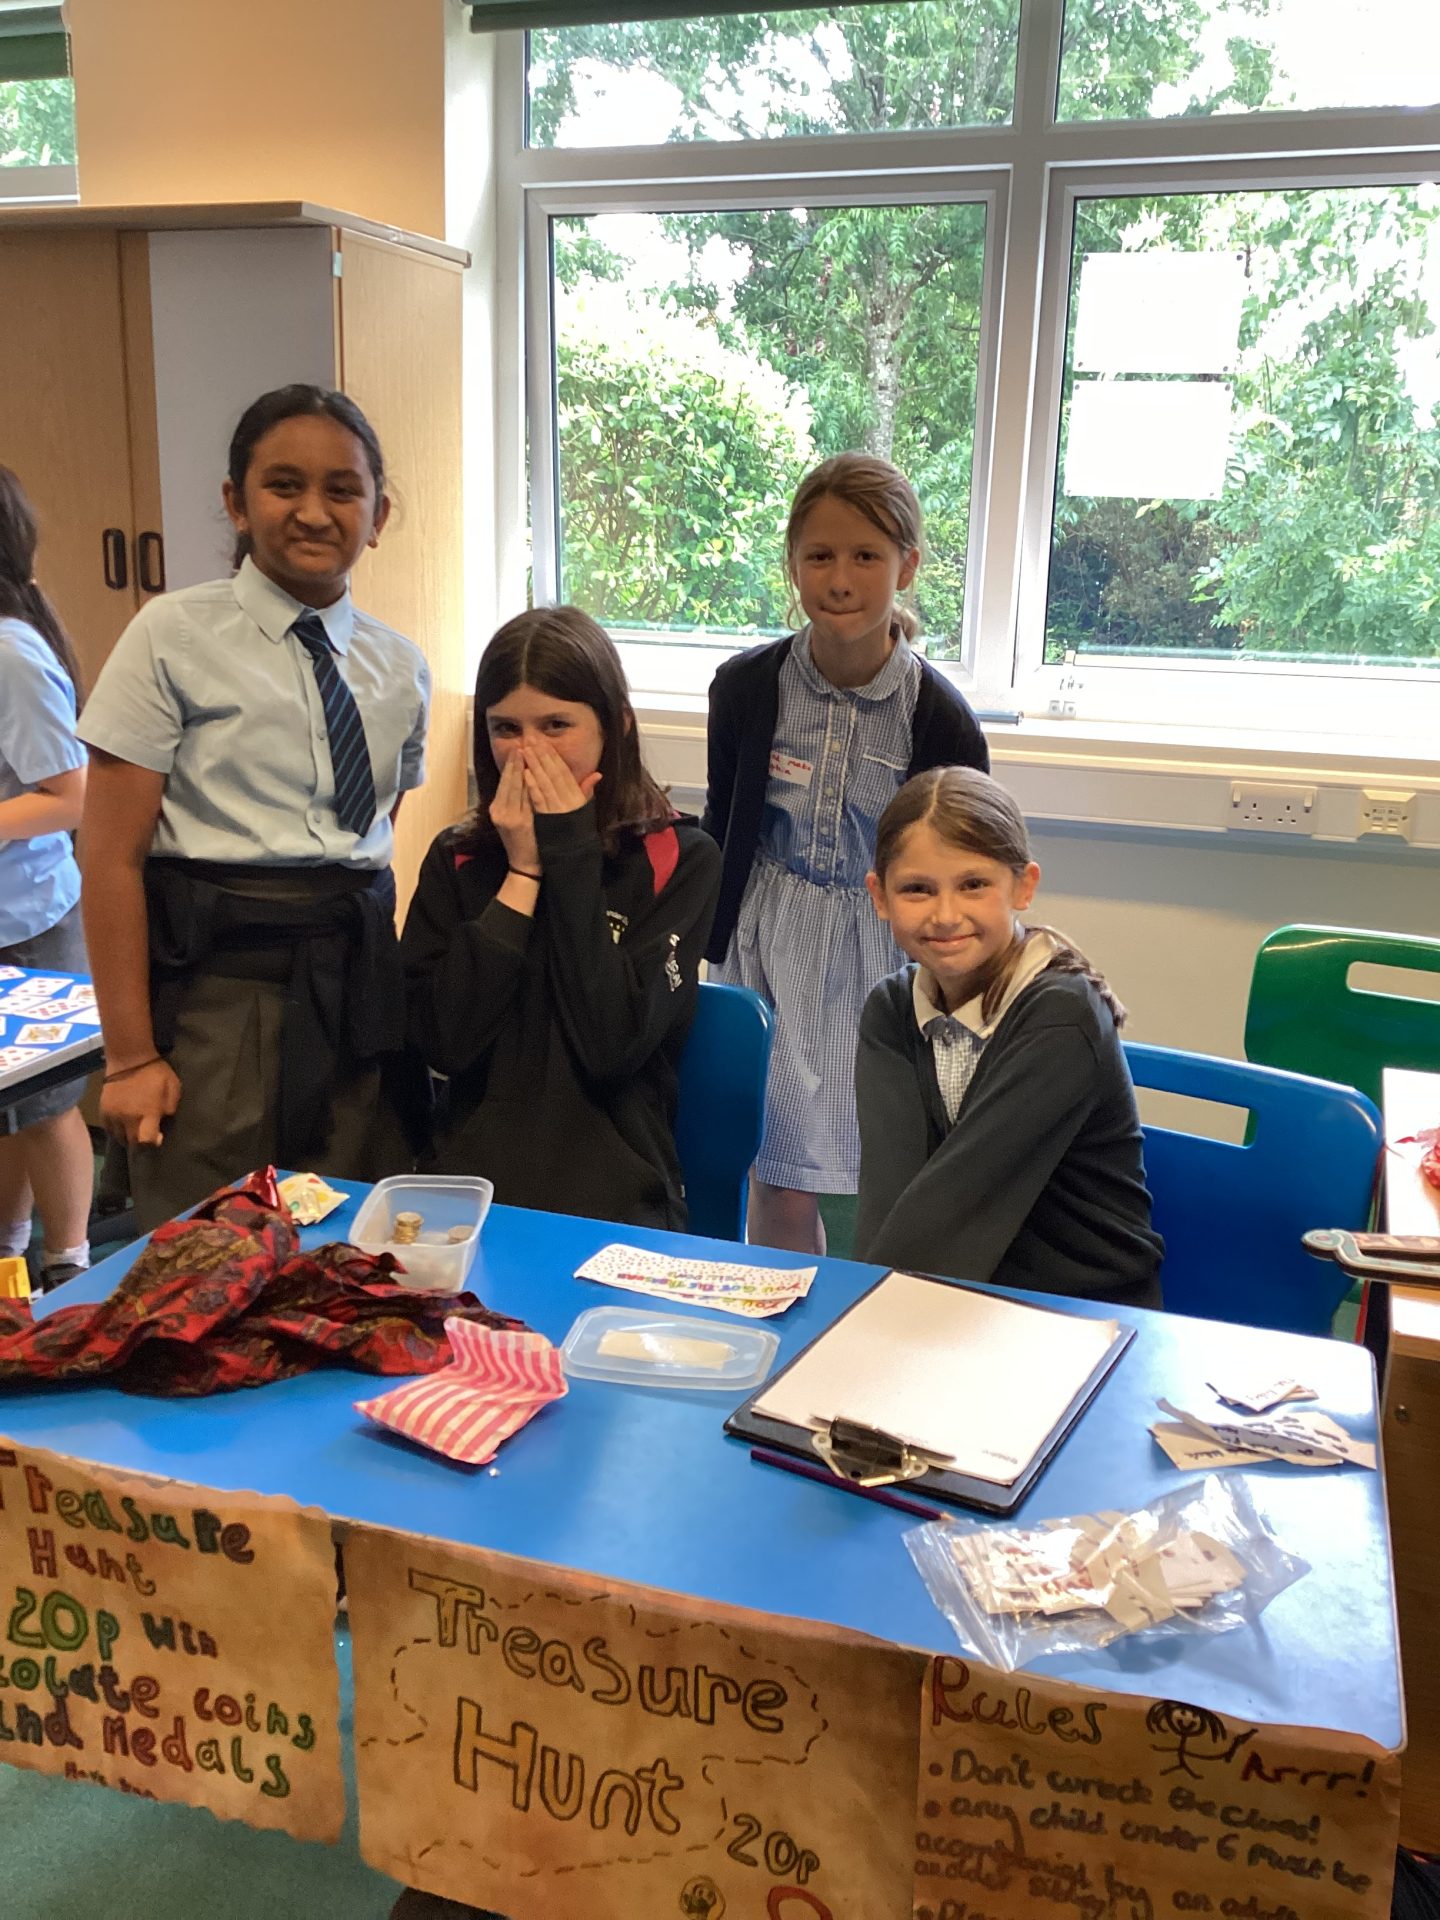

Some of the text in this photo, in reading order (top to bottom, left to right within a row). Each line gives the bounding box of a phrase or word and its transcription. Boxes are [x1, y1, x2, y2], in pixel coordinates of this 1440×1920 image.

[27, 1527, 156, 1596] Hunt
[7, 1587, 120, 1660] 20p
[408, 1568, 788, 1733] Treasure
[932, 1655, 1107, 1744] Rules
[453, 1697, 684, 1835] Hunt
[951, 1749, 1035, 1790] Don't
[727, 1814, 820, 1885] 20p
[1029, 1801, 1108, 1835] child
[1216, 1833, 1240, 1861] 6
[1333, 1860, 1372, 1895] be
